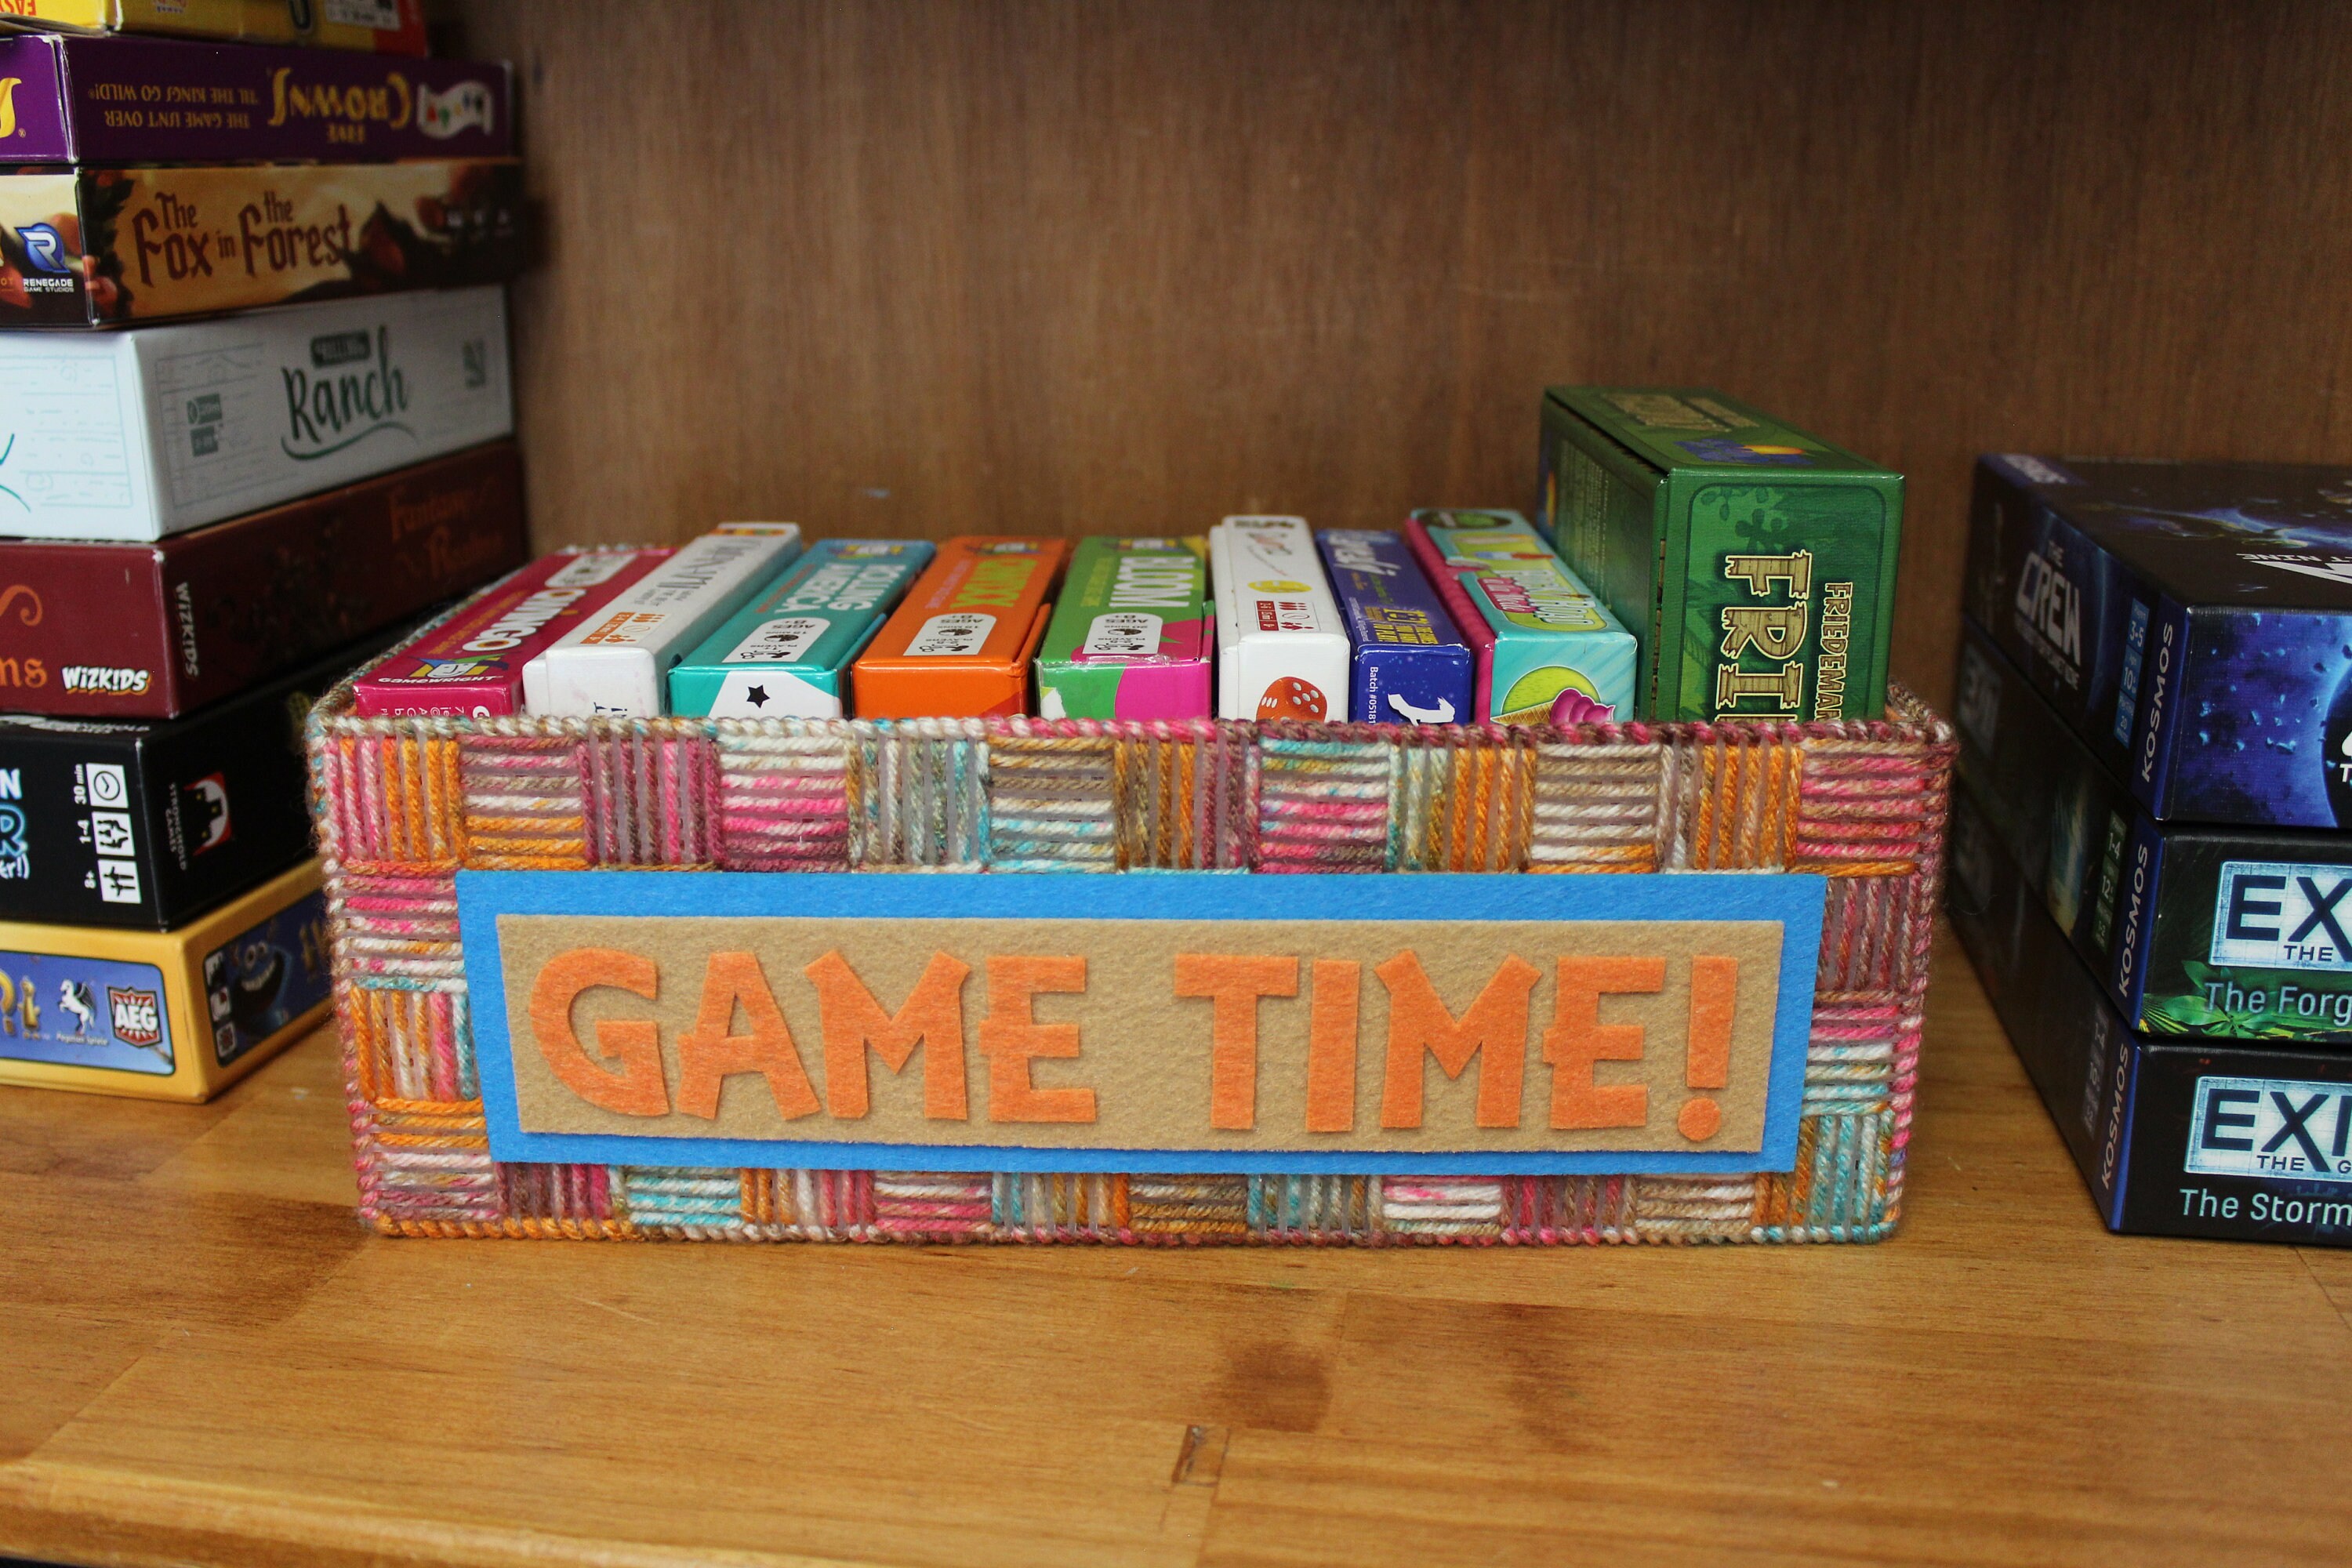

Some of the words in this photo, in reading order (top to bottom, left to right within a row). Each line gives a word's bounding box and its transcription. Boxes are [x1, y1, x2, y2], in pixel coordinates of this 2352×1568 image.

[140, 84, 161, 102] GO
[104, 110, 143, 128] OVER
[185, 112, 223, 129] GAME
[154, 191, 198, 230] The
[263, 191, 293, 223] the
[132, 208, 213, 289] Fox
[216, 230, 235, 260] in
[238, 203, 351, 278] Forest
[22, 278, 74, 287] RENEGADE
[281, 325, 408, 445] Ranch
[1109, 557, 1196, 608] BLOOM
[2016, 550, 2081, 667] CREW
[1715, 549, 1813, 722] FRI
[2129, 621, 2145, 648] 3-5
[1369, 666, 1379, 692] Batch
[2141, 621, 2173, 783] KOSMOS
[74, 764, 85, 784] min
[74, 785, 87, 805] 30
[78, 819, 92, 844] 1-4
[2108, 832, 2121, 860] 1-4
[84, 870, 96, 890] 8+
[2118, 843, 2148, 998] KOSMOS
[2283, 945, 2334, 962] THE
[2204, 981, 2267, 1014] The
[115, 1004, 158, 1032] AEG
[528, 946, 1096, 1124] GAME
[1178, 950, 1738, 1142] TIME!
[2101, 1043, 2129, 1191] KOSMOS
[2256, 1155, 2306, 1171] THE
[2180, 1188, 2239, 1219] The
